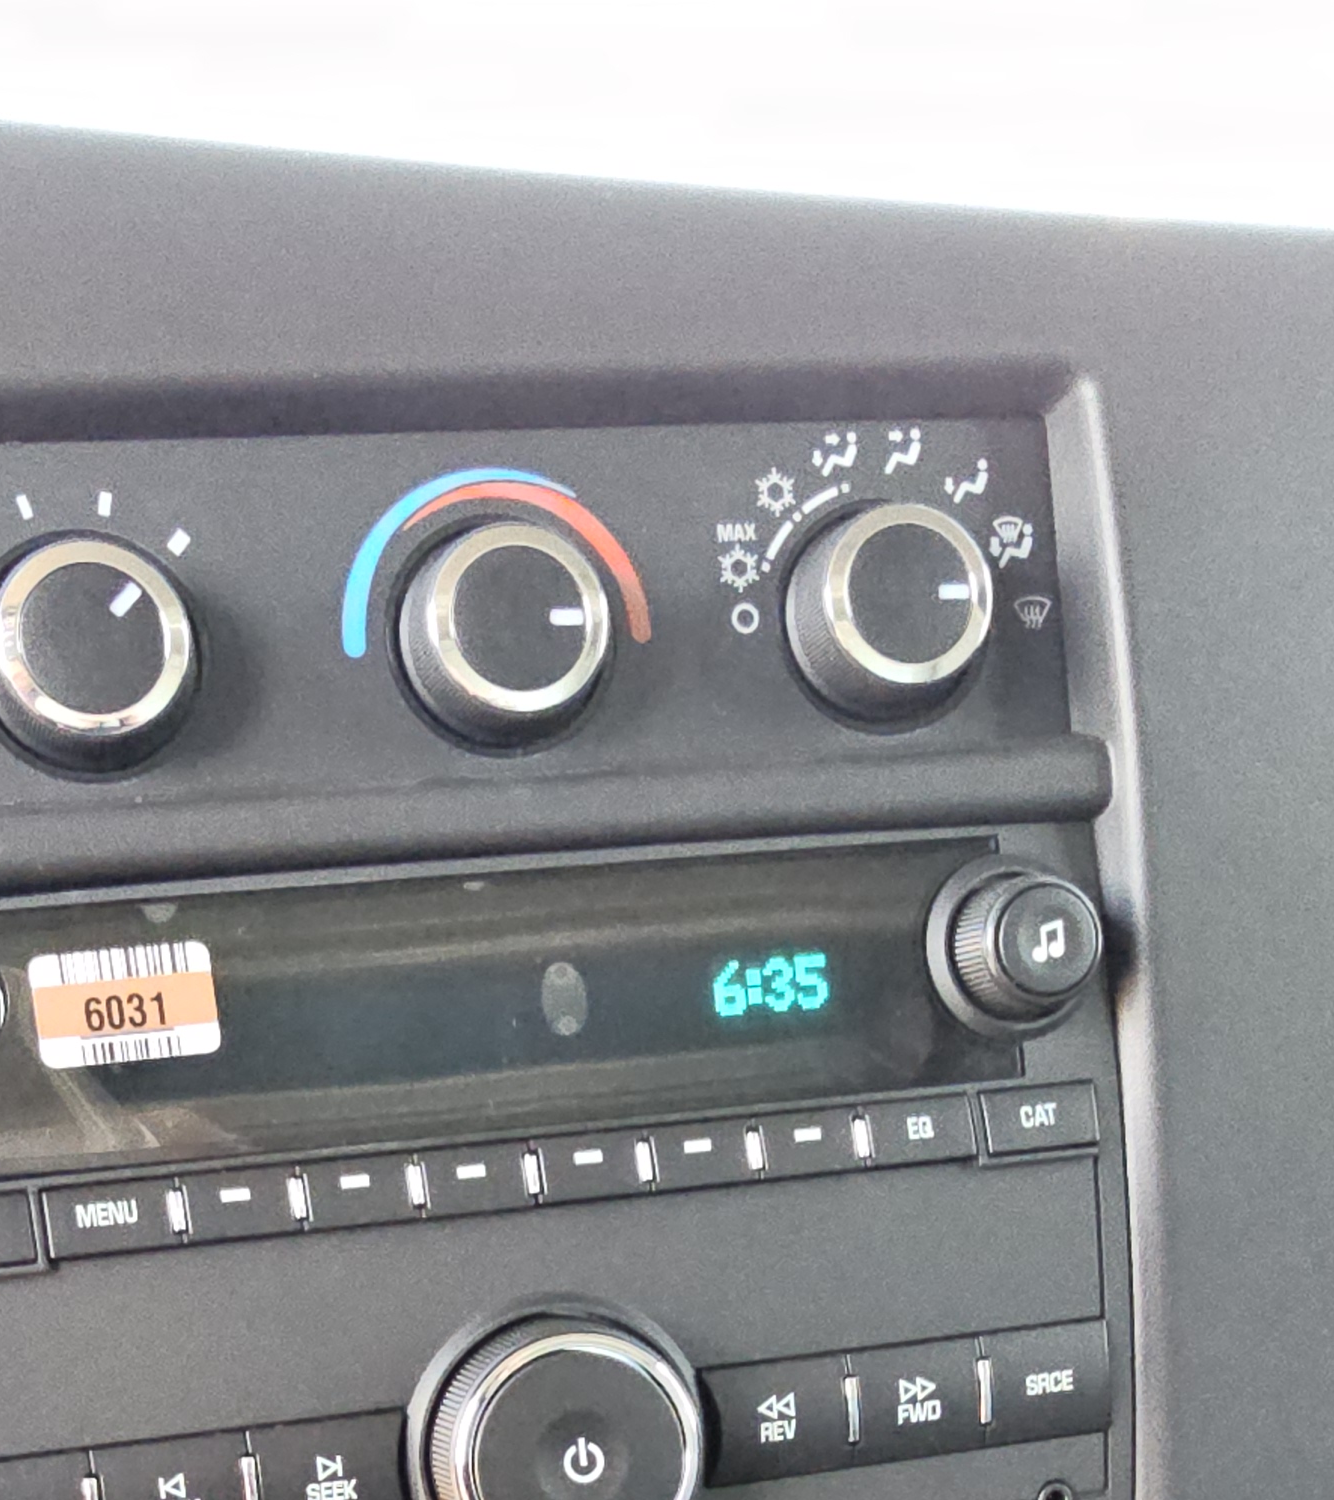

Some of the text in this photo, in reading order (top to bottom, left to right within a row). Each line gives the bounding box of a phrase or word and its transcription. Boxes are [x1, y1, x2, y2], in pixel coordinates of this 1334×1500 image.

[717, 523, 756, 543] MAX
[712, 952, 829, 1018] 6:35
[85, 993, 165, 1033] 6031
[907, 1116, 934, 1139] EQ
[1020, 1103, 1056, 1128] CAT
[75, 1199, 138, 1228] MENU
[1025, 1369, 1074, 1396] SRCE
[898, 1399, 942, 1425] FWD
[760, 1417, 796, 1443] REV
